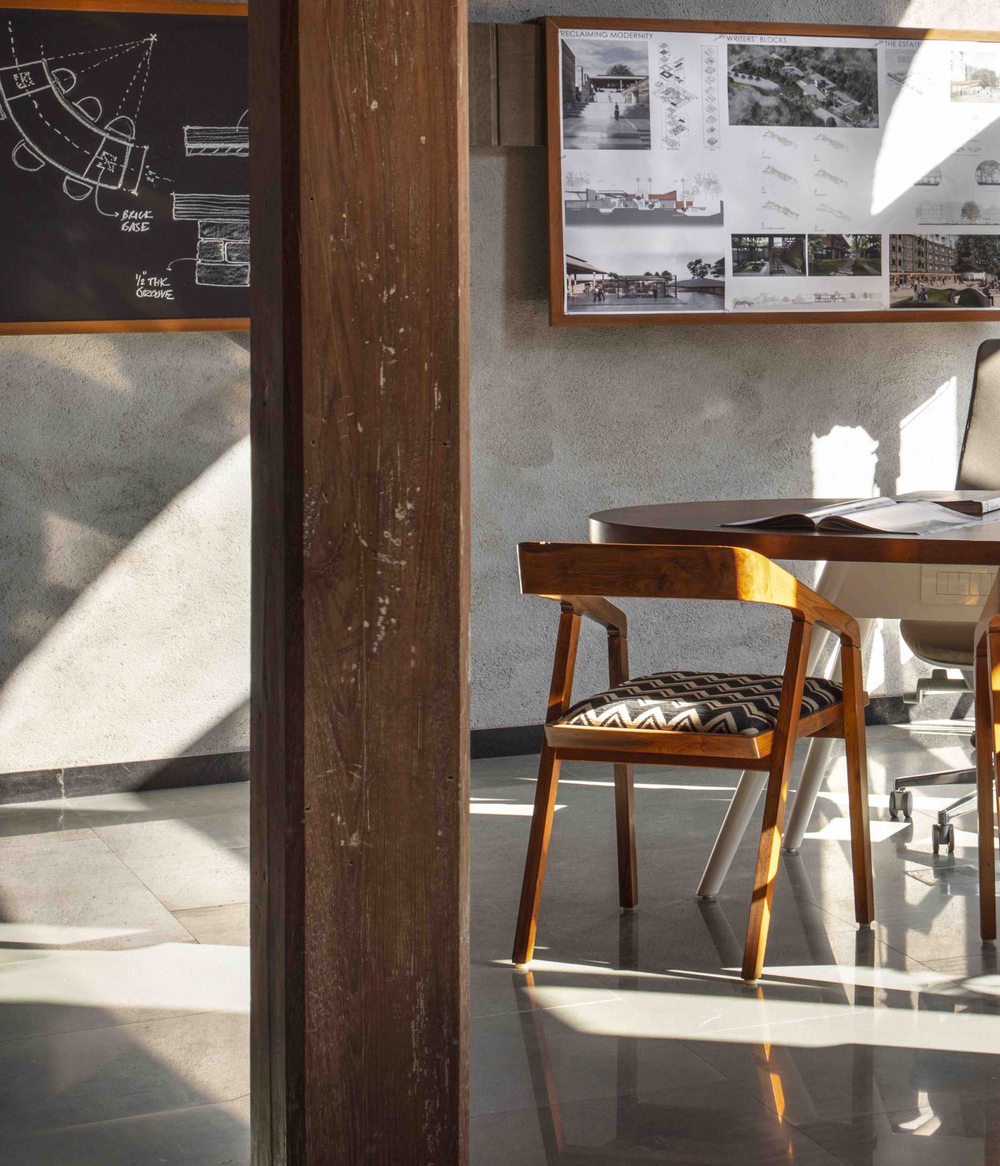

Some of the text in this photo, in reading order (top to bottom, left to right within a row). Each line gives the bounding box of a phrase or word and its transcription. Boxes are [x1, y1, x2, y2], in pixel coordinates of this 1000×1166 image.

[561, 30, 608, 38] RECLAIMING
[120, 209, 154, 221] BRICK
[121, 221, 150, 233] BASE
[147, 277, 171, 287] THK
[136, 286, 175, 300] GROOVE
